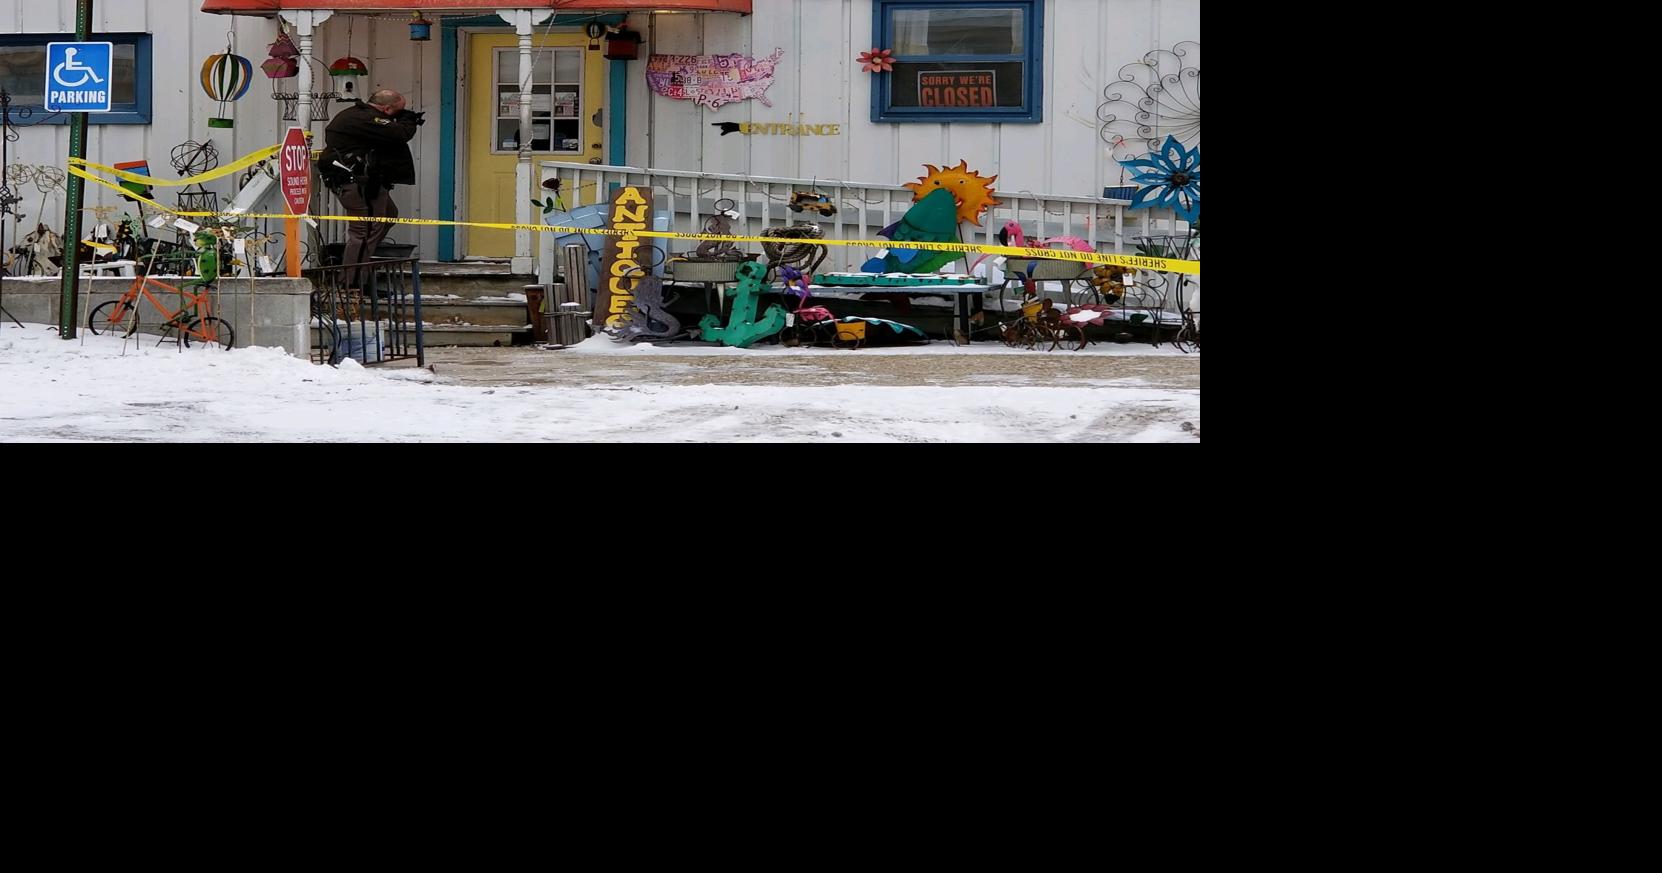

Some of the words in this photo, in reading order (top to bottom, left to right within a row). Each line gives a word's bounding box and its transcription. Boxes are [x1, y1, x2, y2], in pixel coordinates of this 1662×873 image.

[922, 76, 954, 86] SORRY
[960, 76, 992, 84] WE'RE
[50, 90, 106, 104] PARKING
[922, 86, 992, 107] CLOSED
[740, 122, 840, 136] ENTRANCE
[286, 145, 306, 172] STOP
[1024, 249, 1056, 258] CROSS
[1060, 251, 1078, 260] NOT
[1080, 252, 1093, 261] DO
[1098, 254, 1117, 264] LINE
[1121, 256, 1167, 268] SHERIFF'S
